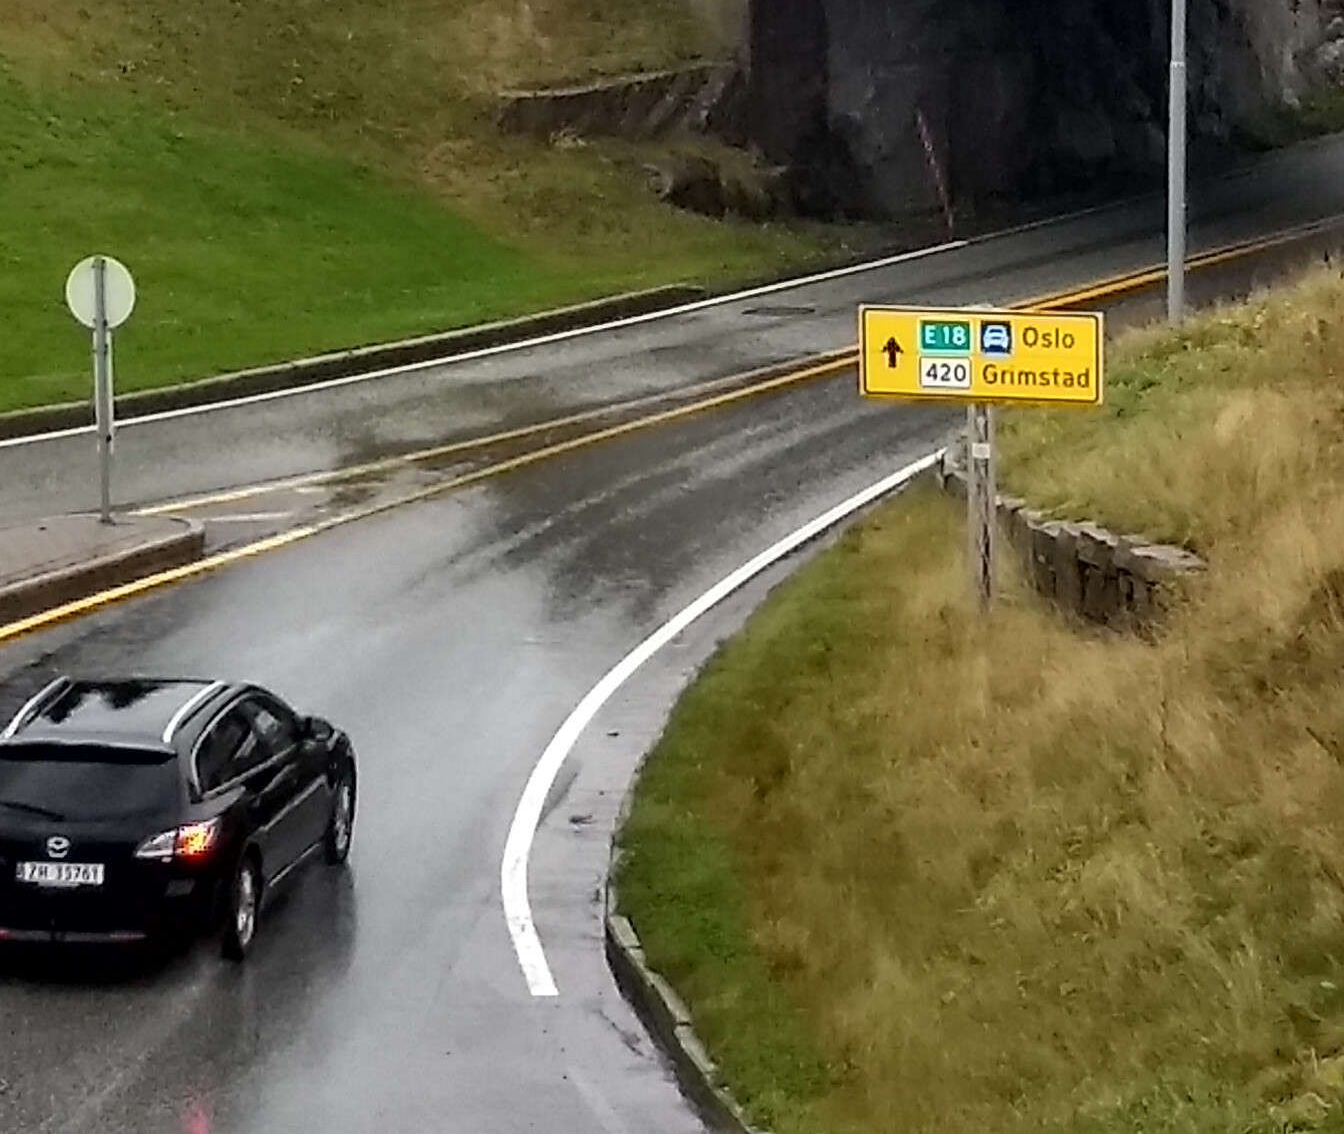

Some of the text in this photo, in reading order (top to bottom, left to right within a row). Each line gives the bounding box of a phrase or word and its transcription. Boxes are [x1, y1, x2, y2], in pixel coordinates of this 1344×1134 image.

[1022, 326, 1075, 349] Oslo
[926, 362, 1090, 388] 420 Grimstad
